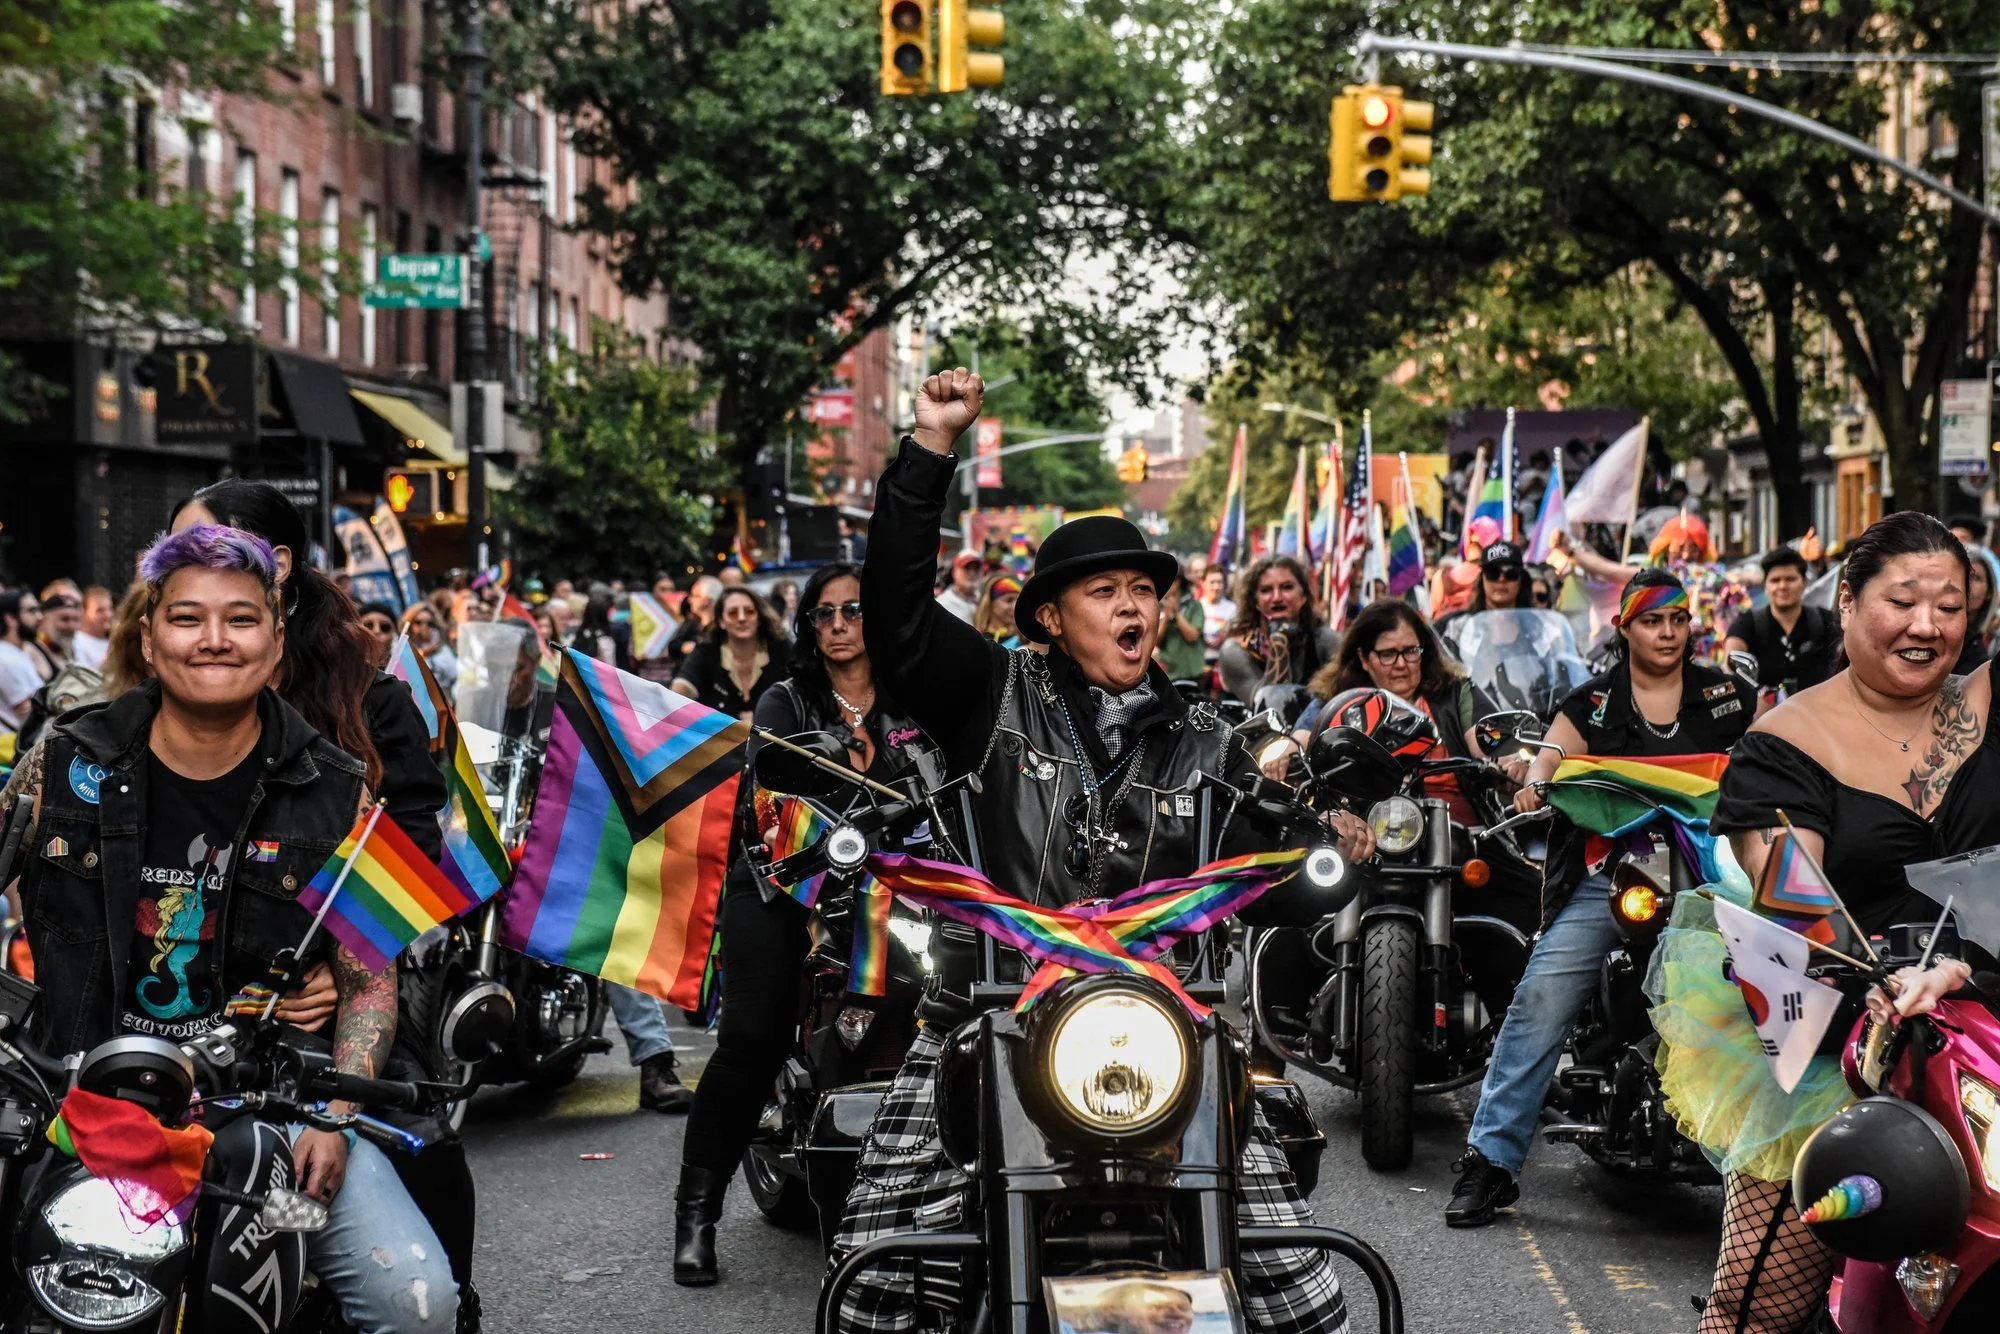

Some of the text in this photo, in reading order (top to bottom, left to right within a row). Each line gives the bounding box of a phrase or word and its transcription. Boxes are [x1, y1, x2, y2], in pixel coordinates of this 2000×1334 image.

[77, 782, 97, 799] Milk
[141, 866, 196, 886] RENS
[121, 1011, 155, 1034] EW
[210, 1011, 224, 1026] C
